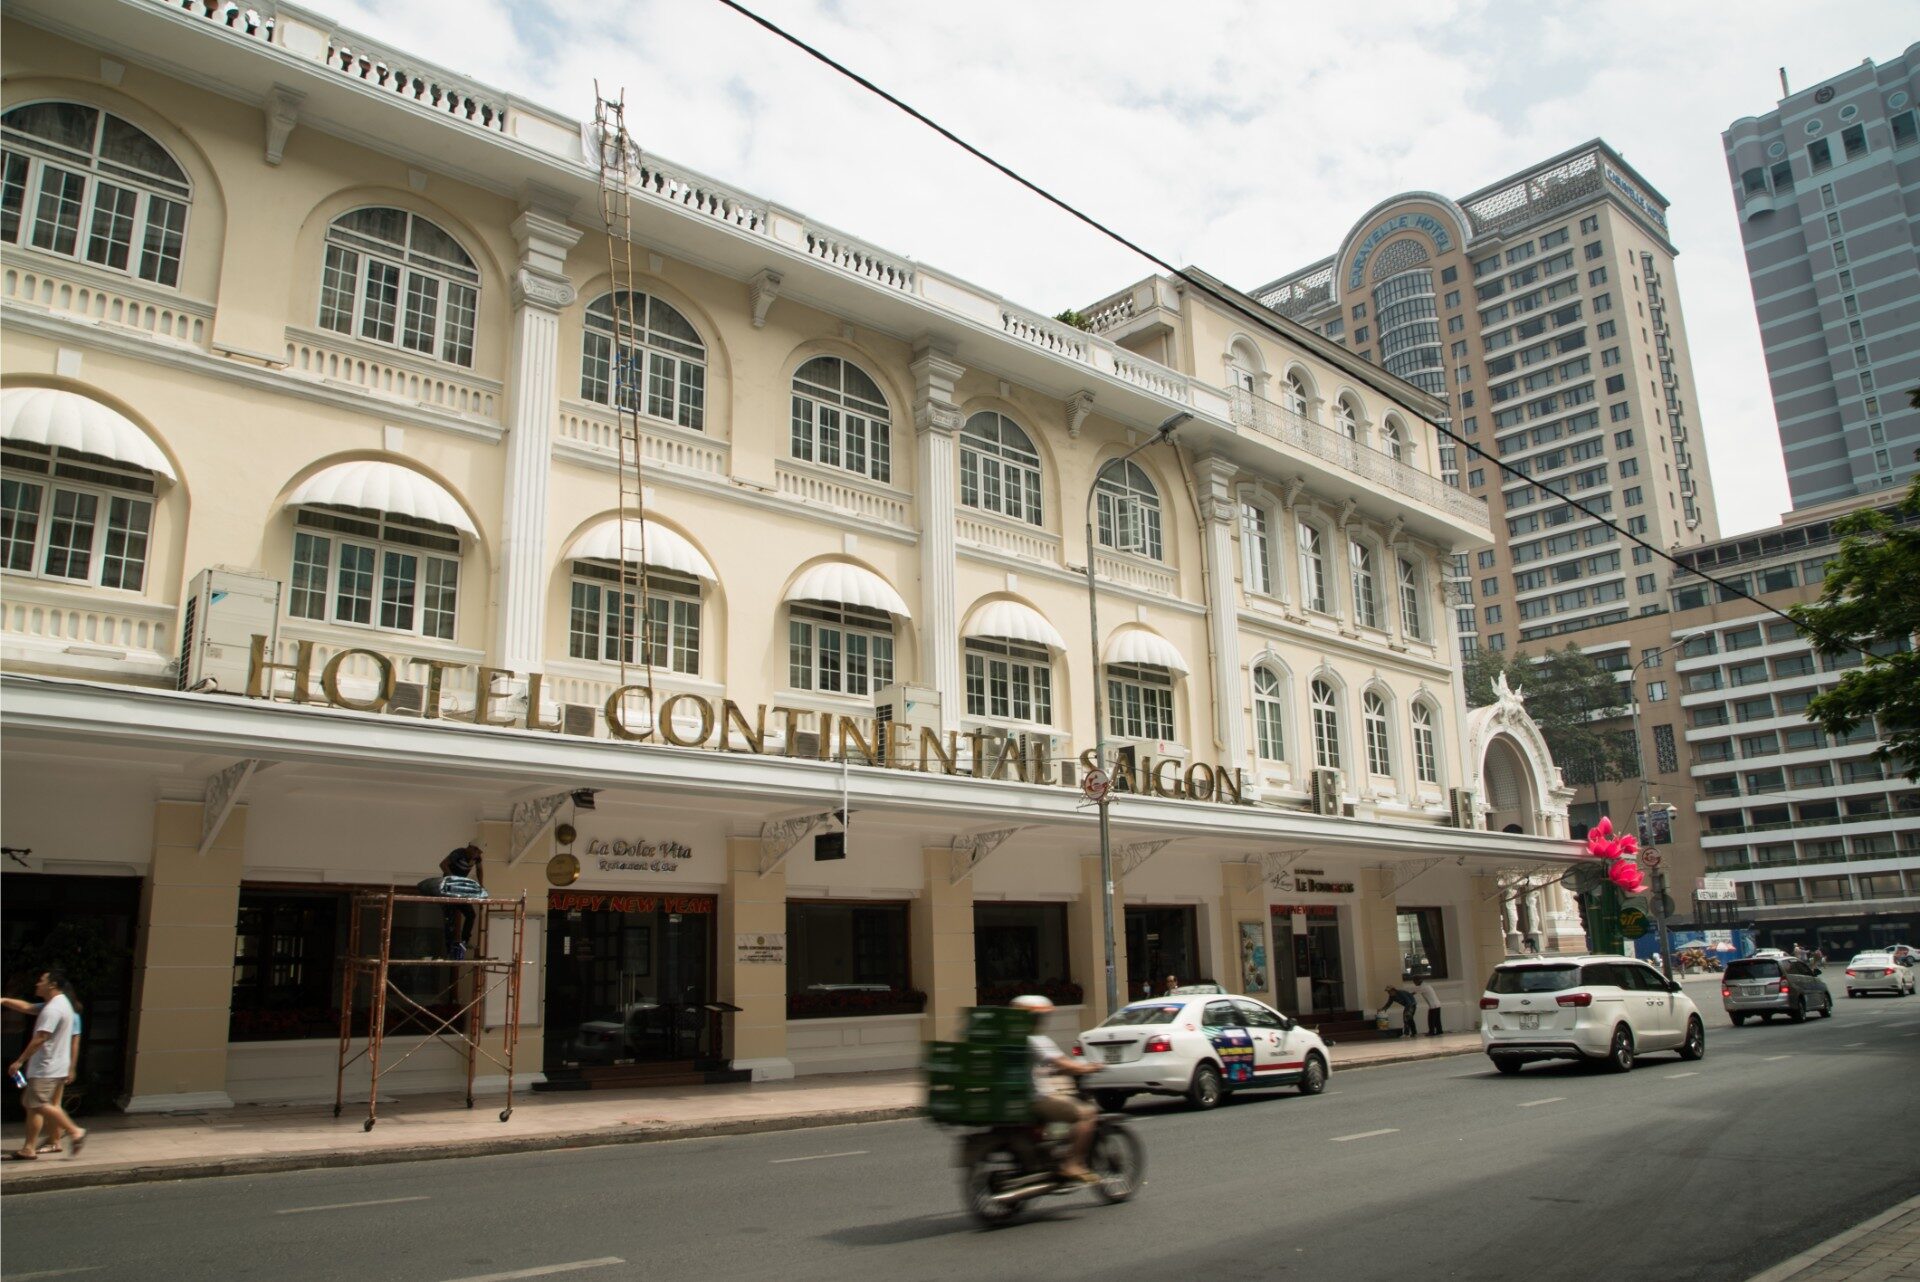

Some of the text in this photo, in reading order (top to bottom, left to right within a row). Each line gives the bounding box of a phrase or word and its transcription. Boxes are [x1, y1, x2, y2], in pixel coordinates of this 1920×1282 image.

[1351, 216, 1450, 288] CARAVELLE HOTEL
[246, 634, 563, 731] HOTEL
[604, 685, 1057, 785] CONTINENTAL
[586, 840, 692, 859] La Dolce Vita
[609, 895, 657, 913] NEW
[664, 897, 713, 914] YEAR
